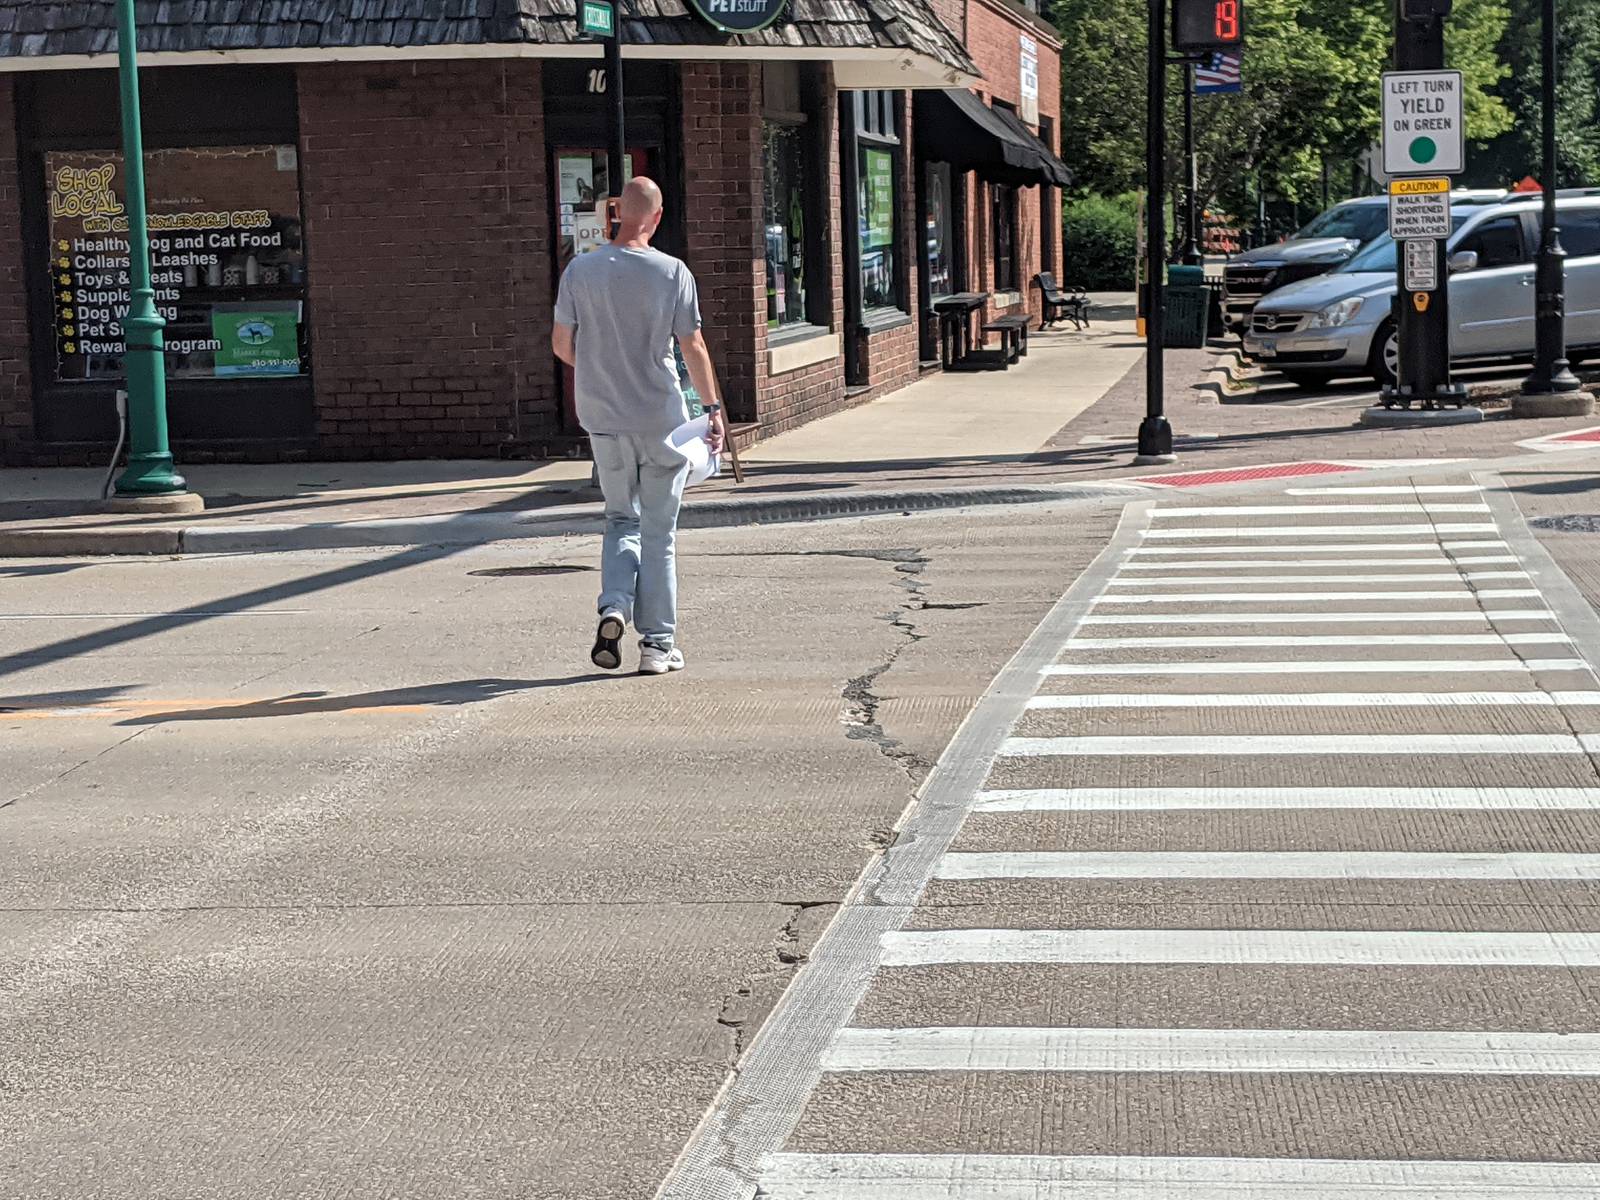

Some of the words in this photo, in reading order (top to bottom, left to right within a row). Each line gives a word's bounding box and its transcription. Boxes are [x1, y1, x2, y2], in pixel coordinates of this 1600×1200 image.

[1216, 0, 1238, 39] 19
[1391, 81, 1419, 94] LEFT
[1423, 80, 1454, 93] TURN
[1400, 97, 1445, 114] YIELD
[1393, 119, 1410, 132] ON
[1414, 117, 1452, 131] GREEN
[57, 163, 116, 194] SHOP
[1399, 181, 1440, 192] CAUTION
[52, 190, 124, 217] LOCAL
[1397, 195, 1420, 204] WALK
[1423, 194, 1441, 203] TIME
[1396, 205, 1444, 215] SHORTENED
[84, 218, 110, 232] WITH
[112, 217, 129, 231] OU
[147, 212, 229, 229] NOWLEDGABLE
[1395, 217, 1419, 225] WHEN
[1420, 215, 1445, 224] TRAIN
[1393, 226, 1447, 236] APPROACHES
[74, 237, 131, 253] Healthy
[150, 238, 170, 252] og
[174, 234, 204, 249] and
[209, 233, 237, 248] Cat
[240, 232, 281, 247] Food
[74, 254, 131, 269] Collars
[152, 252, 218, 267] Leashes
[75, 271, 114, 289] Toys
[118, 270, 130, 285] &
[150, 270, 183, 283] eats
[76, 288, 180, 306] Supplents
[78, 305, 109, 321] Dog
[79, 322, 105, 336] Pet
[80, 340, 127, 354] Rewa
[164, 339, 221, 354] rogram
